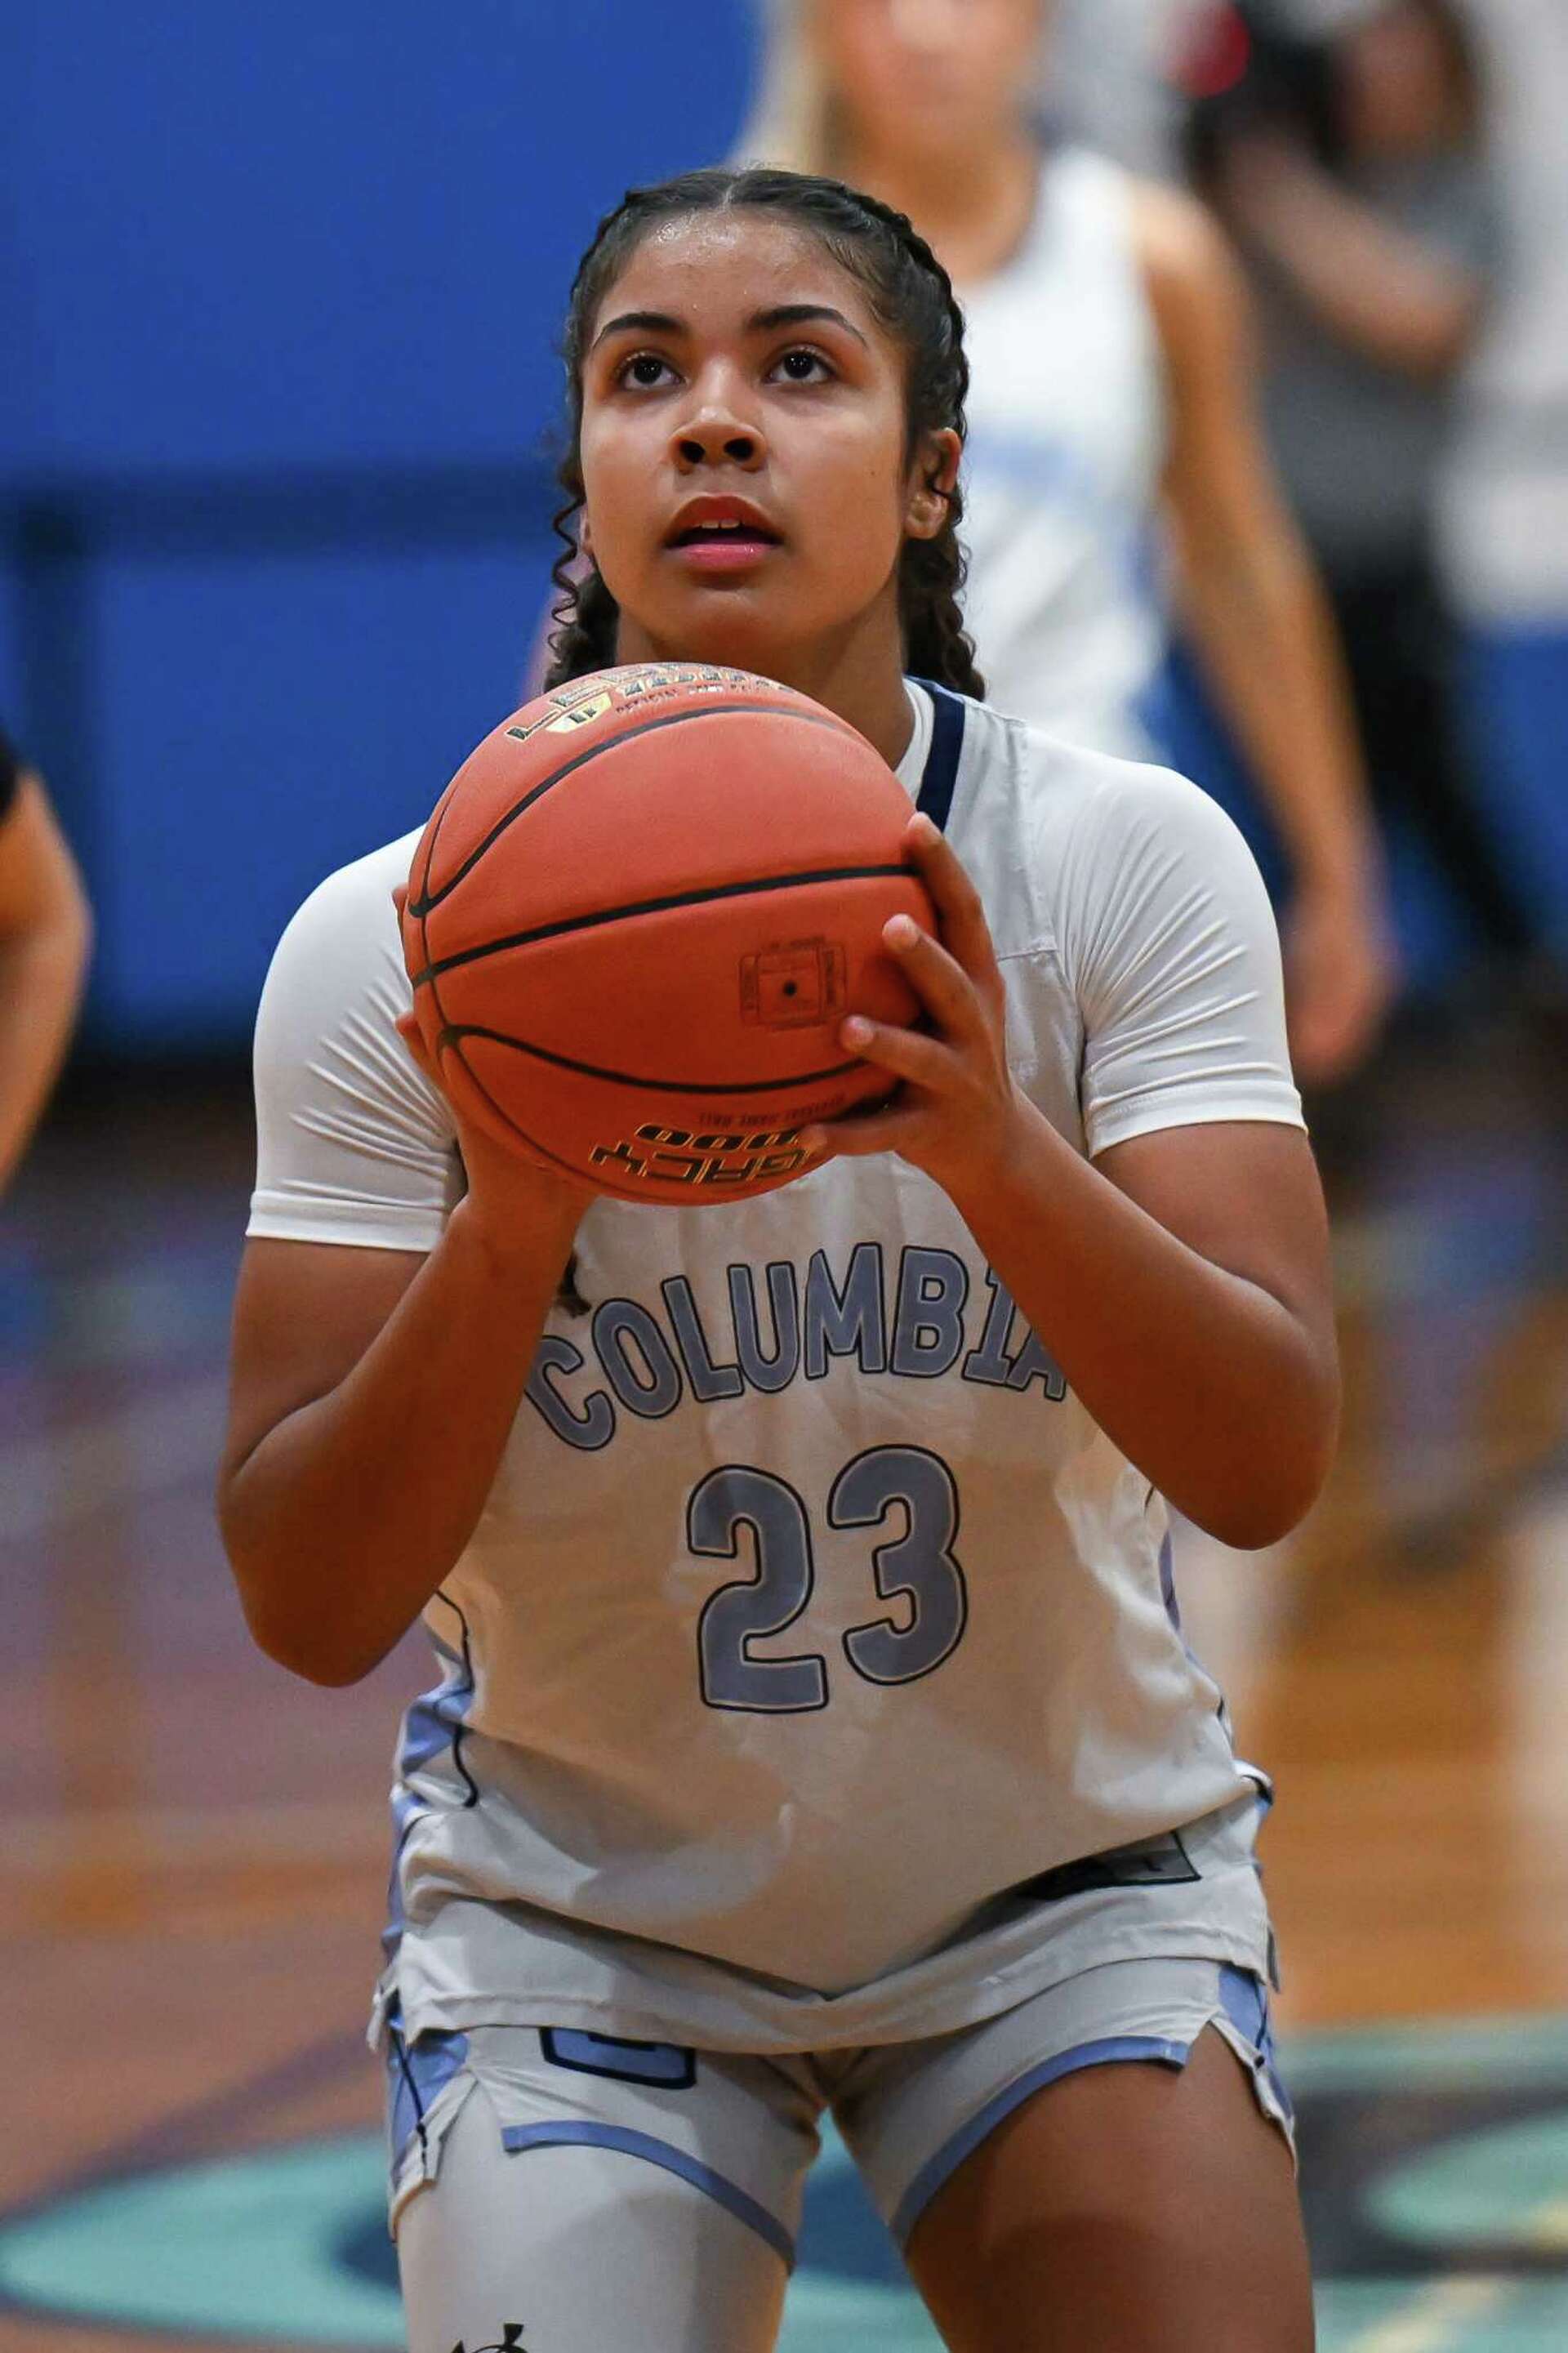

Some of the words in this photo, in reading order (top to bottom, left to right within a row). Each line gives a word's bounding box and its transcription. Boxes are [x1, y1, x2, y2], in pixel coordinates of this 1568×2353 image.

[587, 1139, 812, 1184] GACY
[523, 1242, 1070, 1451] COLUMBIA
[687, 1443, 969, 1714] 23
